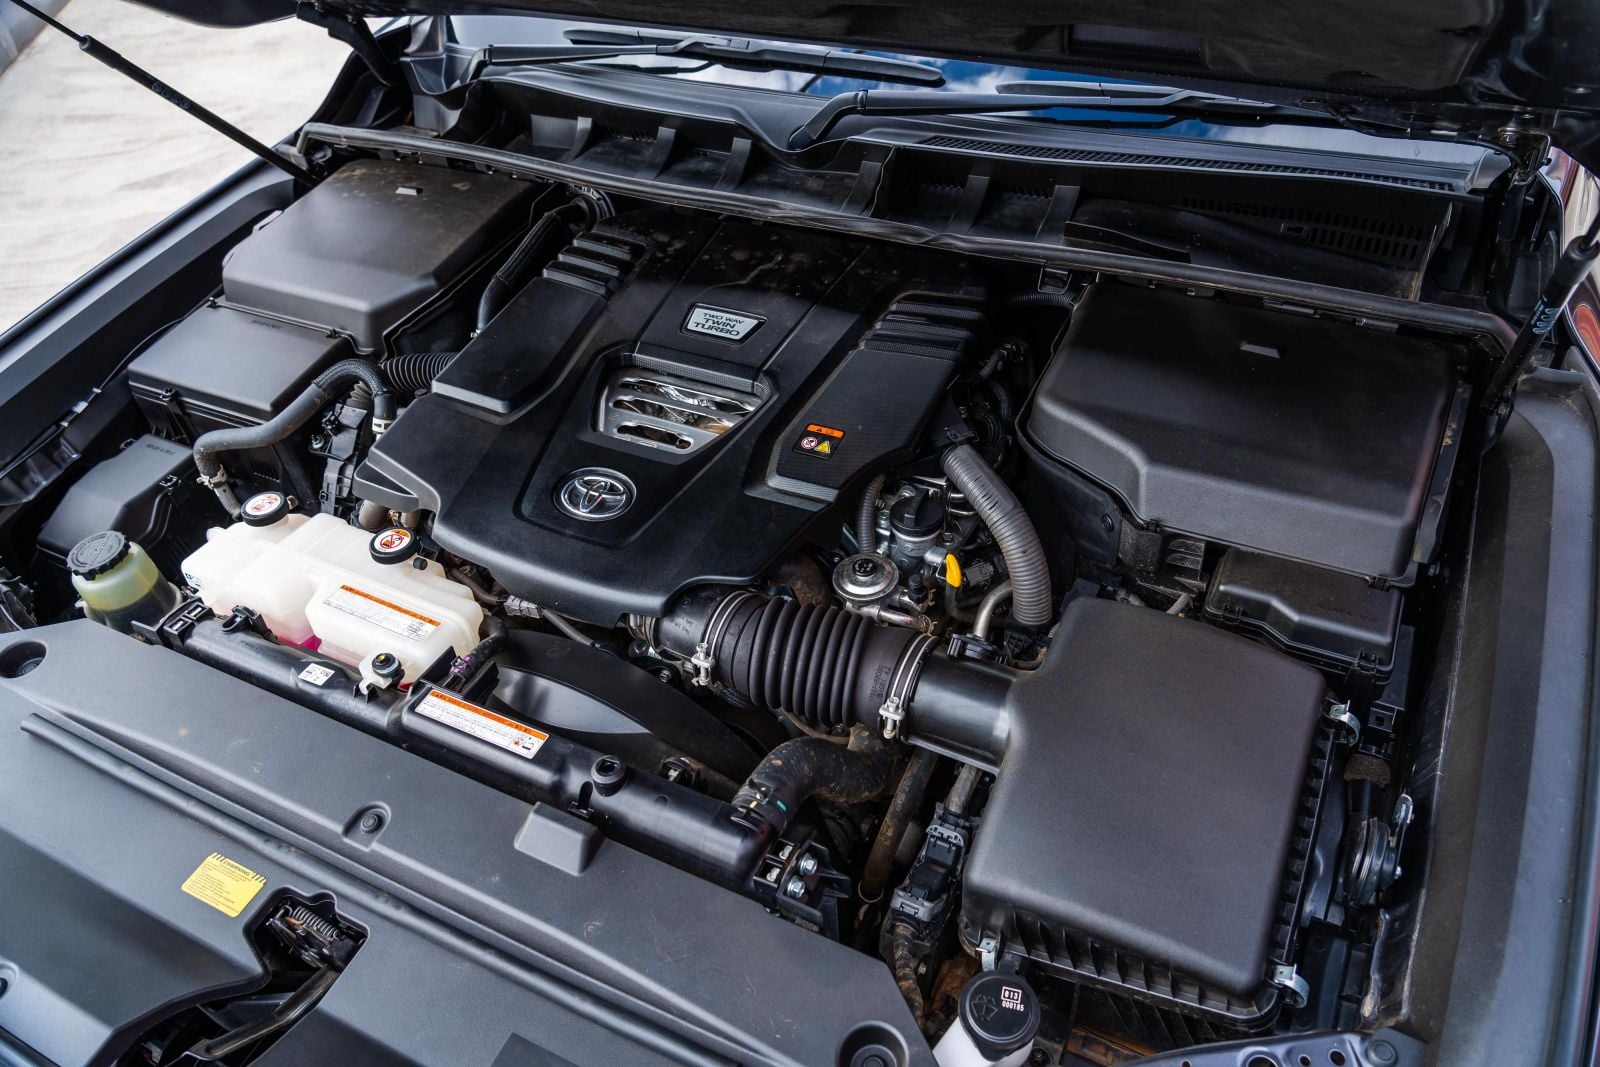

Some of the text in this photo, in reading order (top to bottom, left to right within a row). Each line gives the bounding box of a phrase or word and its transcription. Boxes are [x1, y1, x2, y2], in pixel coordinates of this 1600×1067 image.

[702, 312, 745, 325] TWO WAY
[703, 318, 736, 329] TWIN
[693, 321, 740, 337] TURBO
